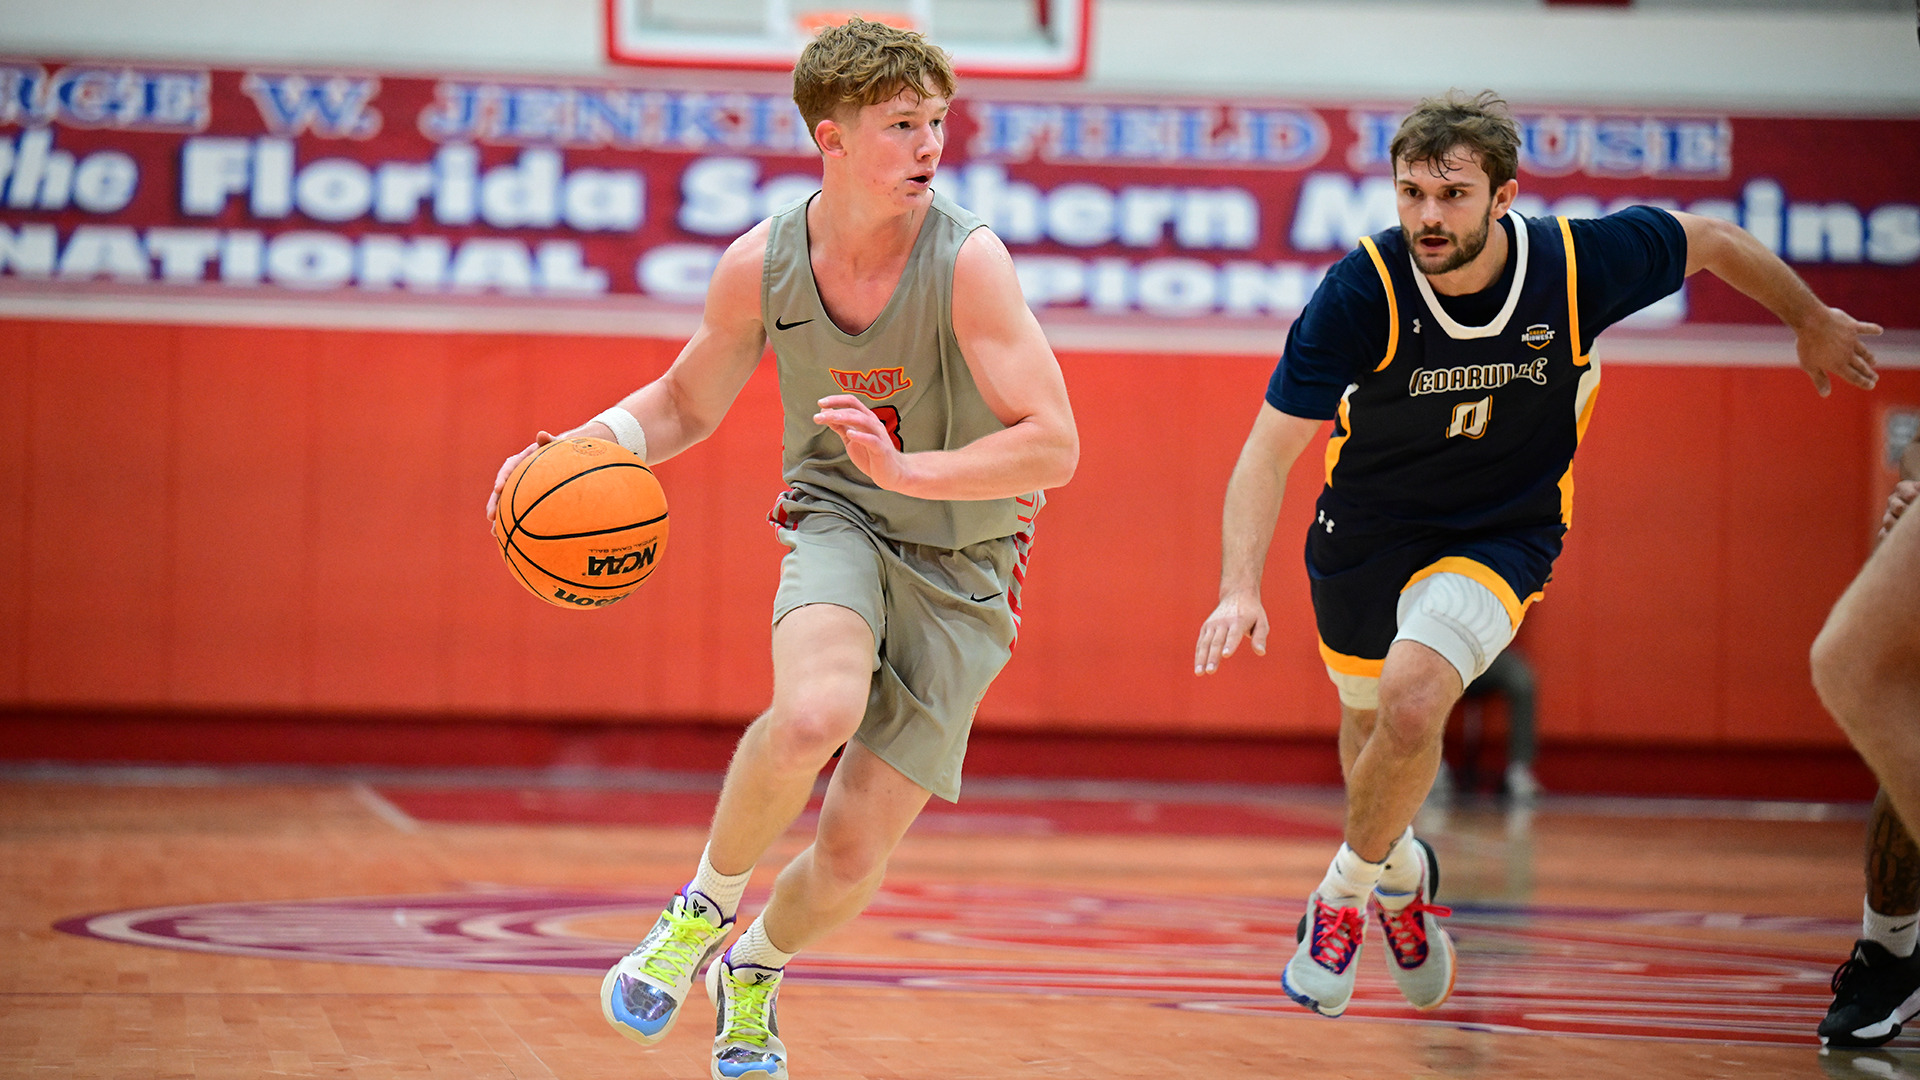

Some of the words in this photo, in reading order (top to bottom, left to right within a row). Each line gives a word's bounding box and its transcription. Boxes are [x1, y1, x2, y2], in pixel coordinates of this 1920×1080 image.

[242, 73, 382, 139] W.
[420, 83, 825, 153] JENKI
[970, 104, 1328, 168] FIELD
[180, 132, 646, 232] Florida
[0, 222, 611, 295] NATIONAL
[829, 366, 913, 400] UMSL
[1446, 394, 1493, 440] 0
[587, 542, 658, 576] NCAA
